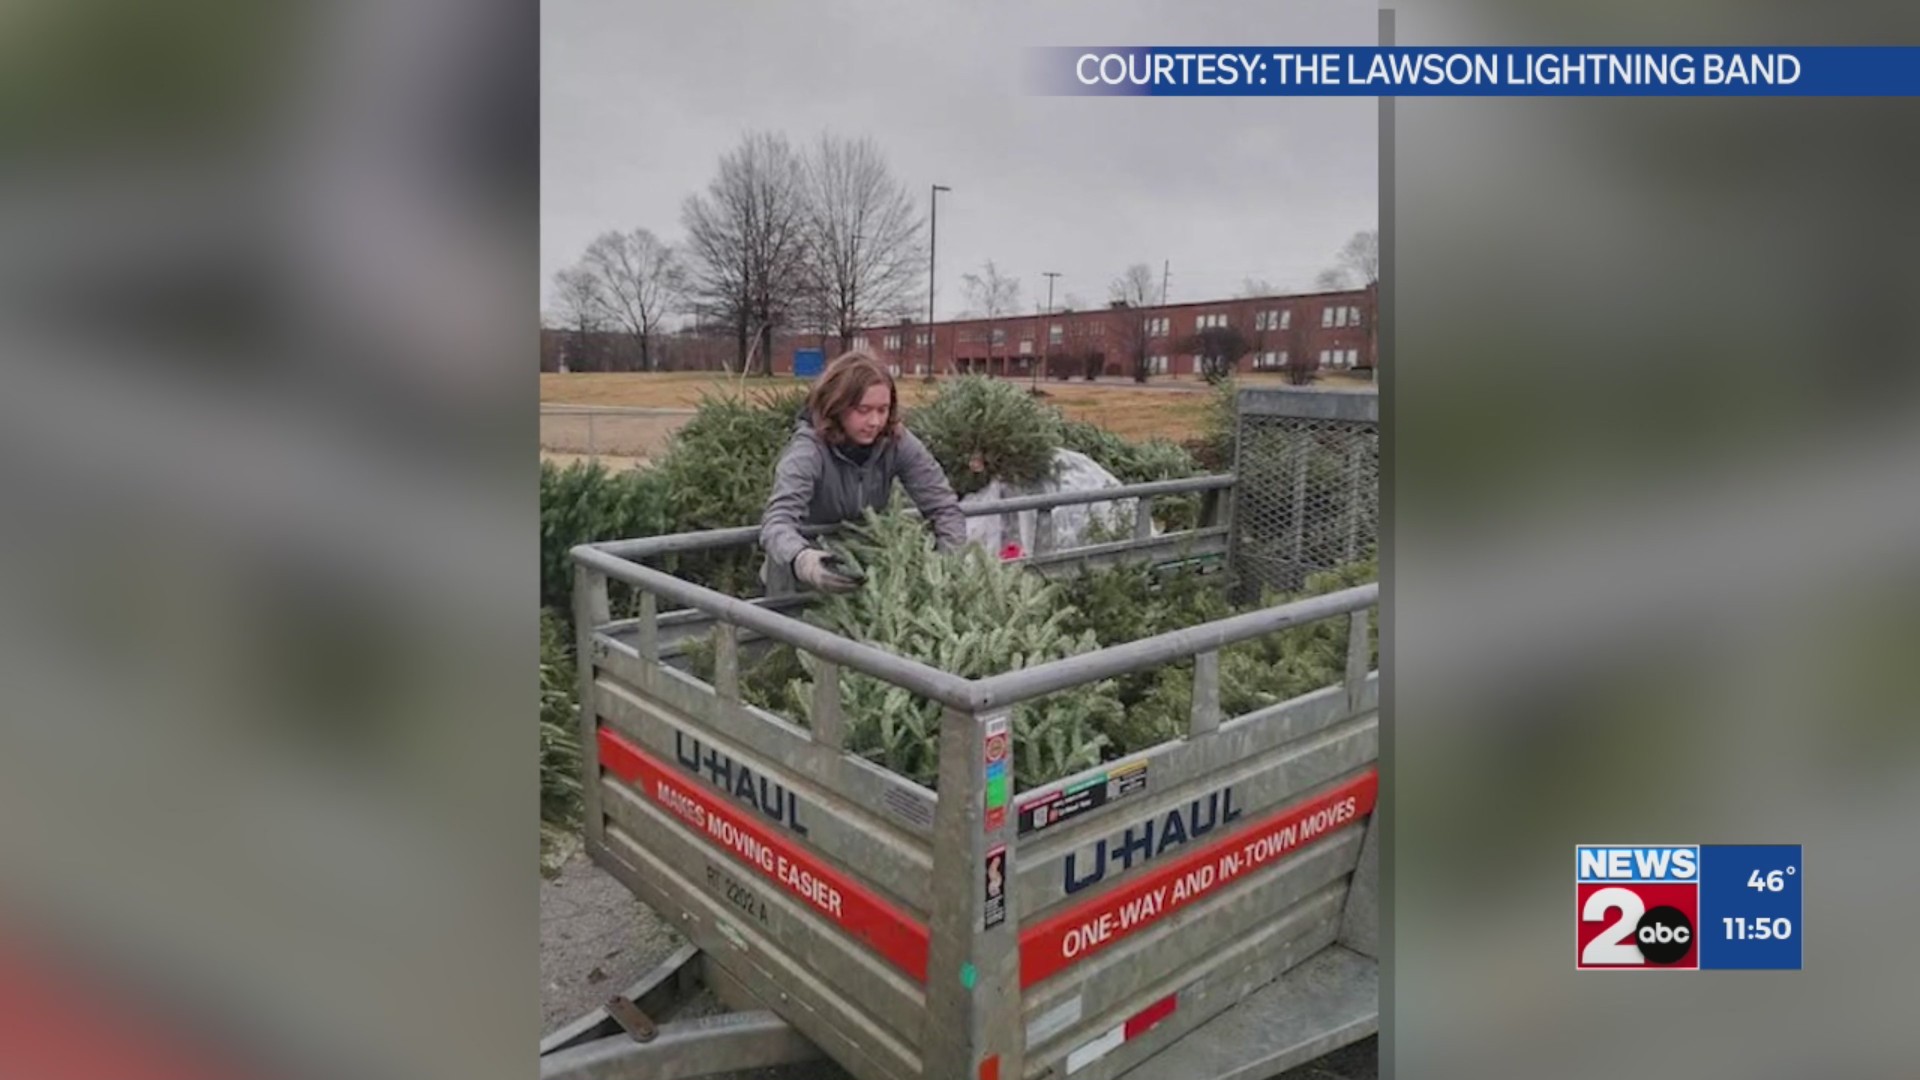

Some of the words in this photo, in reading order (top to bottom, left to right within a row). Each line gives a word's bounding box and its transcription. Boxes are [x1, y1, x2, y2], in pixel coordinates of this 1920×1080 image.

[675, 729, 809, 835] U-HAUL
[1063, 786, 1243, 895] U-HAUL
[656, 780, 705, 828] MAKES
[707, 811, 774, 872] MOVING
[777, 854, 843, 919] EASIER
[1062, 884, 1167, 958] ONE-WAY
[1171, 865, 1215, 905] AND
[1219, 825, 1297, 882] IN-TOWN
[1299, 796, 1356, 838] MOVES
